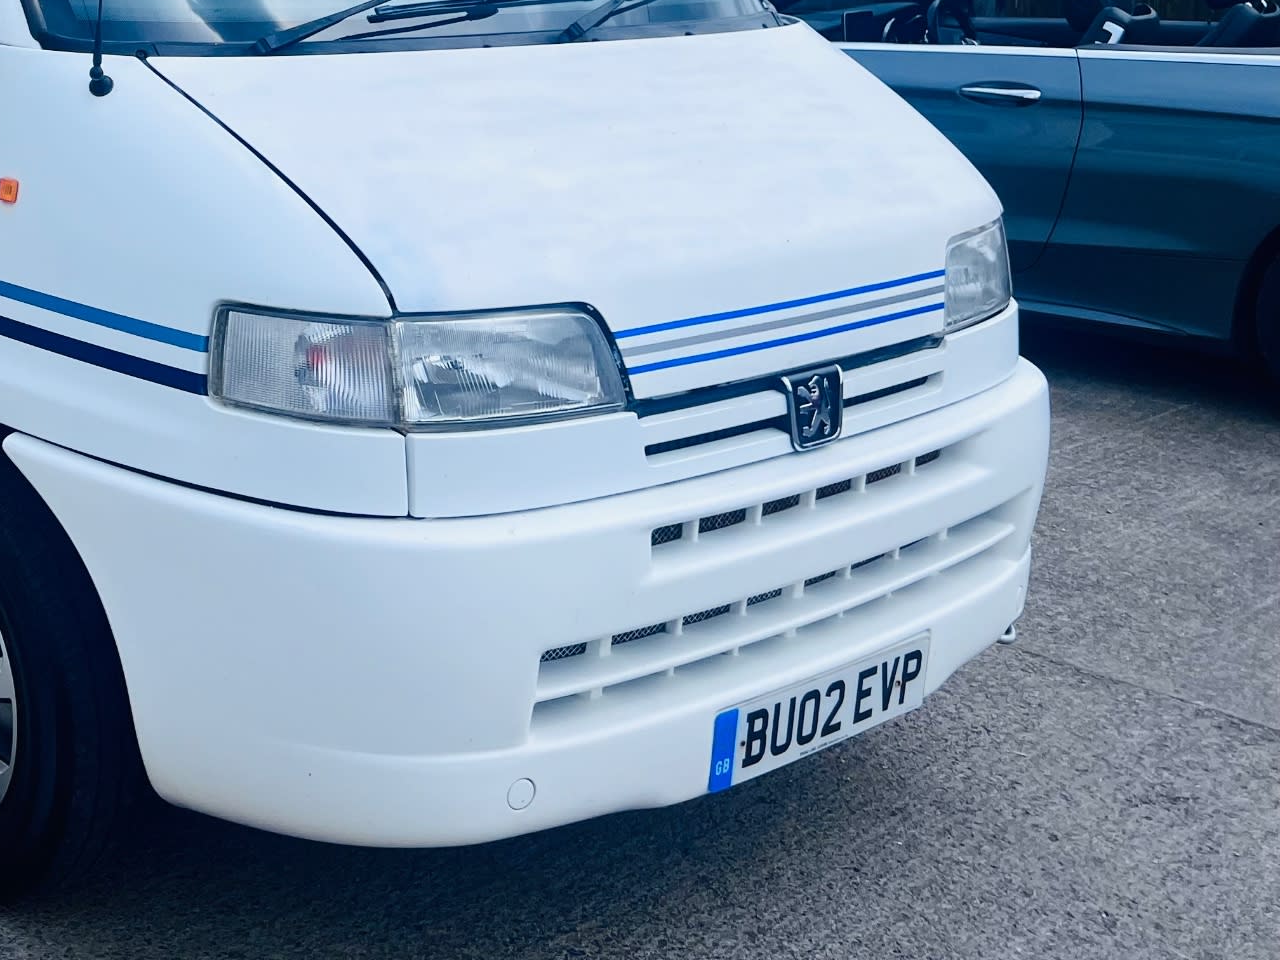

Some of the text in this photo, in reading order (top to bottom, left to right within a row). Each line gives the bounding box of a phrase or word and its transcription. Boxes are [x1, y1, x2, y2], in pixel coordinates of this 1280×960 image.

[742, 649, 923, 769] BU02 EVP
[715, 758, 730, 776] GB
